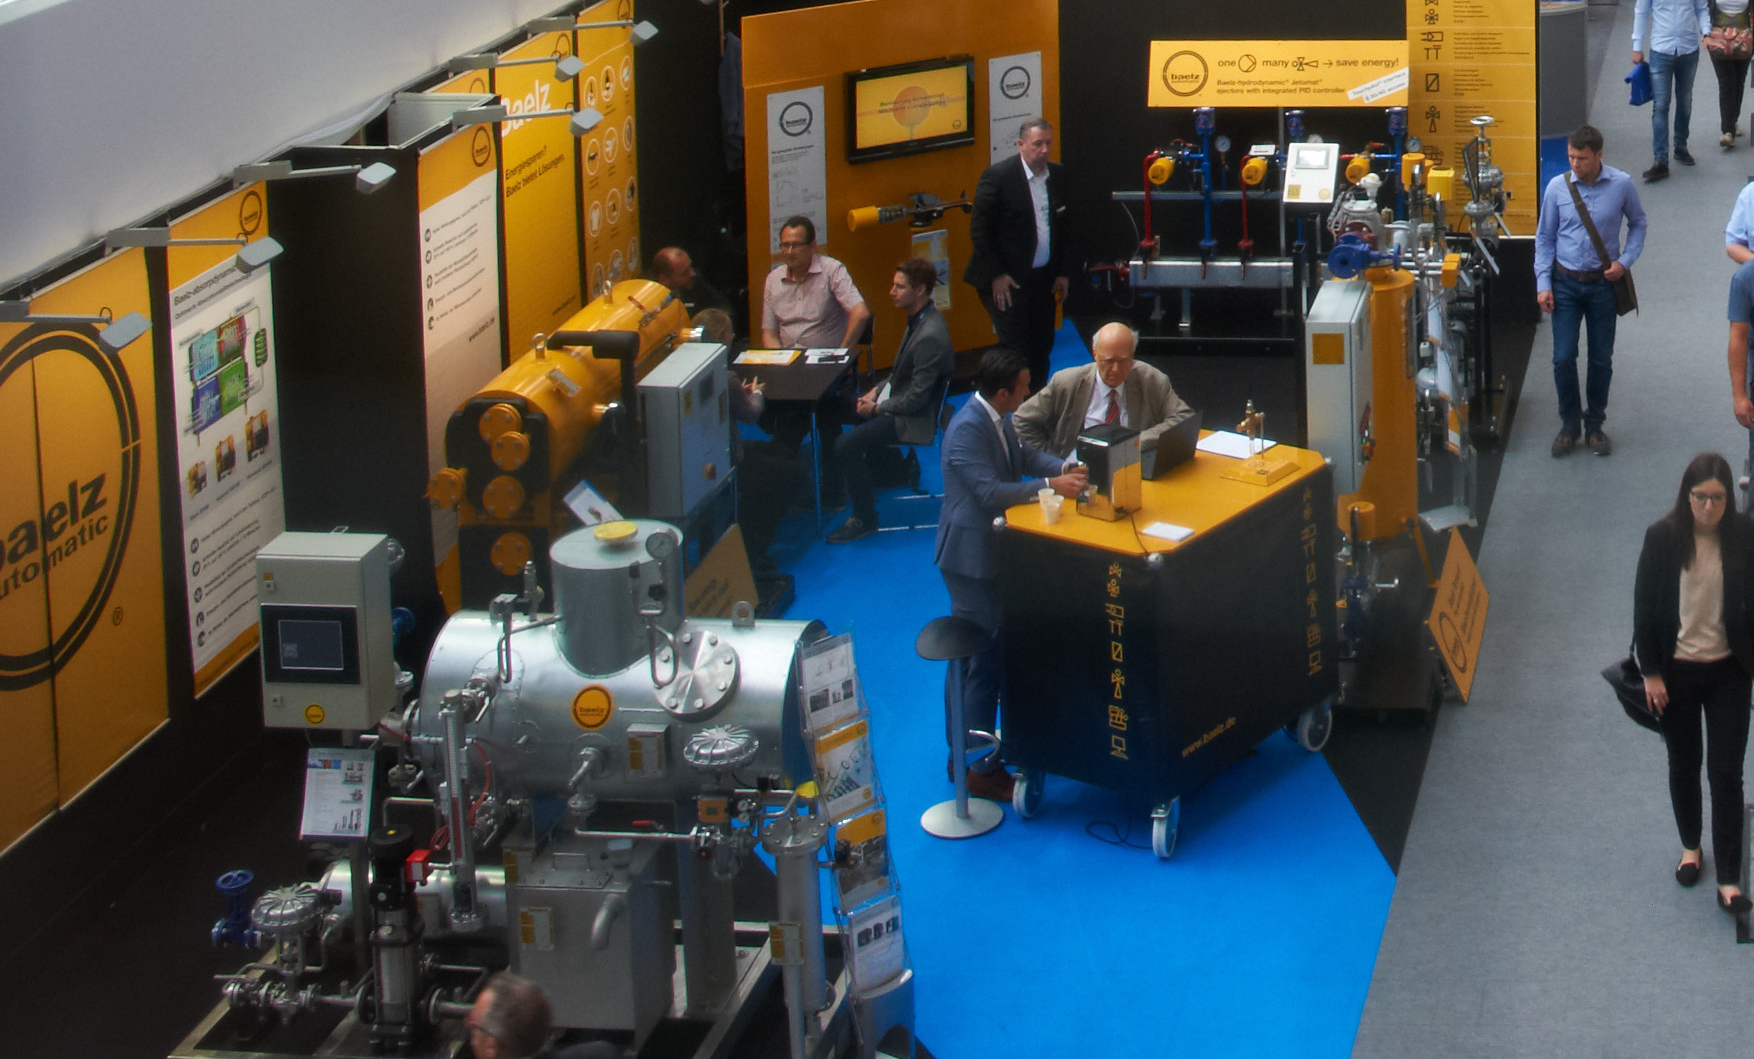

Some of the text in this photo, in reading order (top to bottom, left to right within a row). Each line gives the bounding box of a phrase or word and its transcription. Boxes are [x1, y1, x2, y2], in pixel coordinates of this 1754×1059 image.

[1218, 57, 1399, 70] one many save energy!
[0, 515, 109, 601] utomatic
